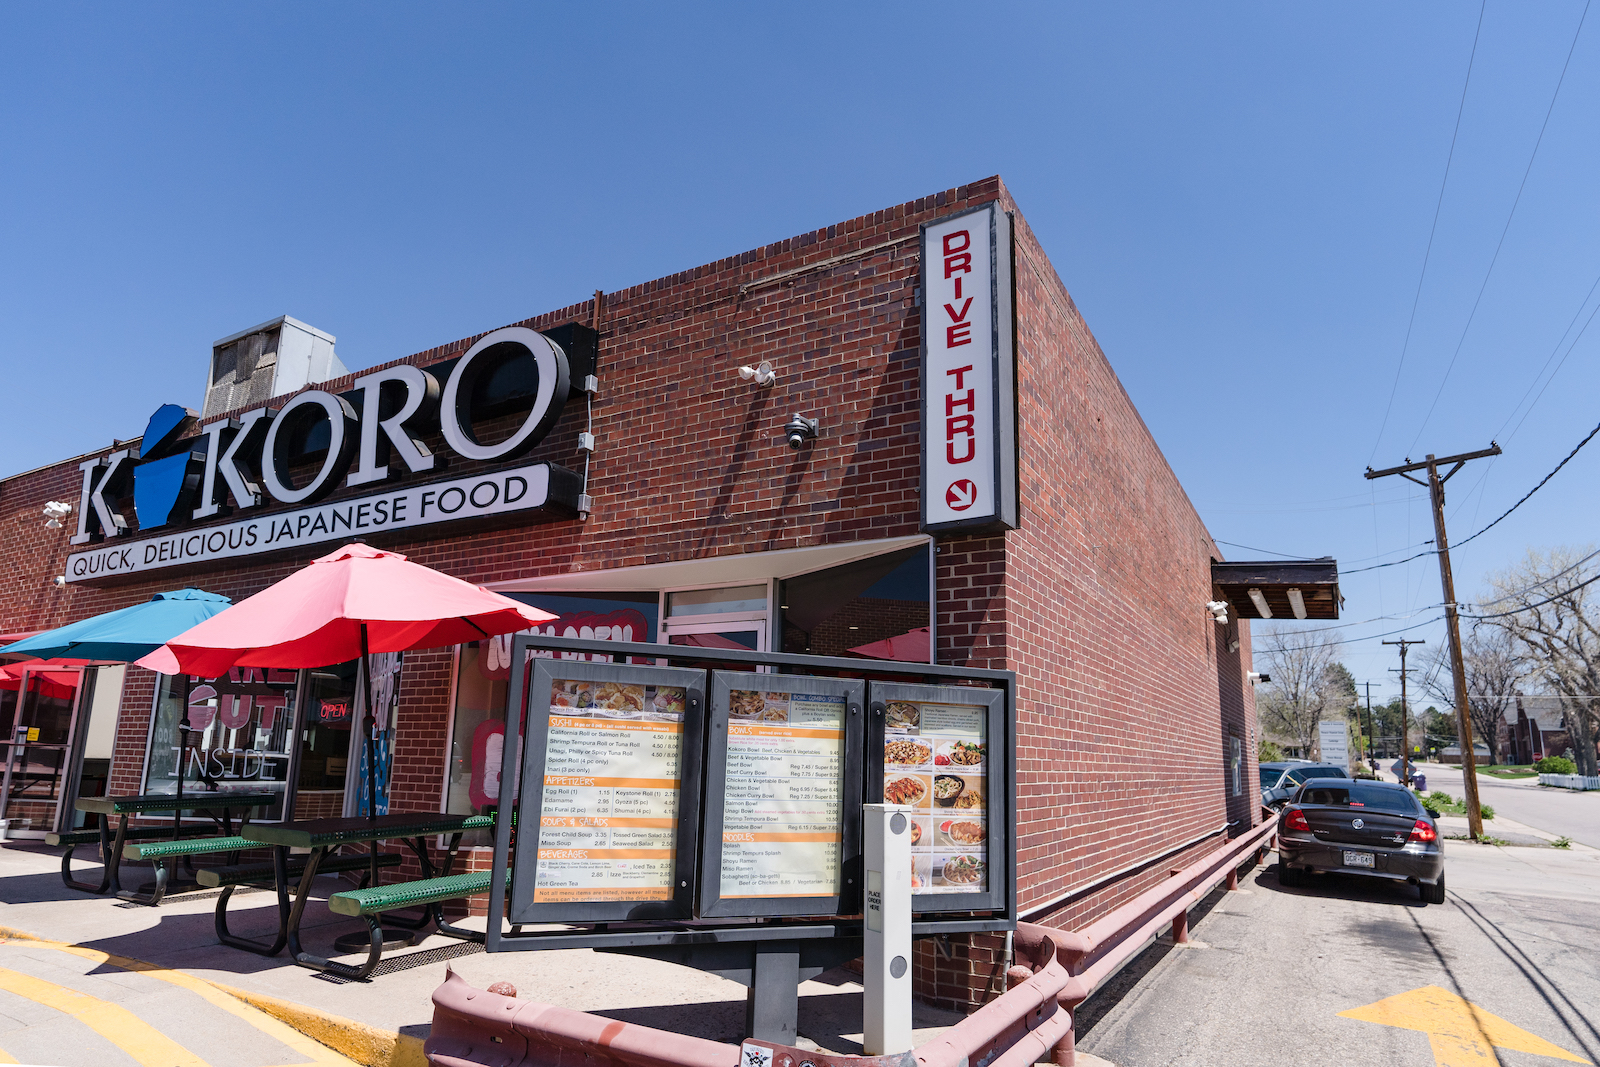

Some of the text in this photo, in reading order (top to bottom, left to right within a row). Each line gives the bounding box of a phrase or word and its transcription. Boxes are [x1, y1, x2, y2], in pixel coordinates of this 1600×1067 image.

[943, 230, 974, 349] DRIVE
[945, 365, 975, 464] THRU
[73, 475, 529, 577] QUICK, DELICIOUS JAPANESE FOOD
[320, 703, 347, 719] OPEN
[551, 718, 572, 726] SUSHI
[729, 727, 752, 735] BOWLS
[546, 776, 595, 786] APPETIZERS
[542, 818, 566, 826] SOUPS
[579, 819, 608, 827] SALADS
[723, 833, 754, 841] NOODLES
[540, 850, 588, 859] BEVERAGES
